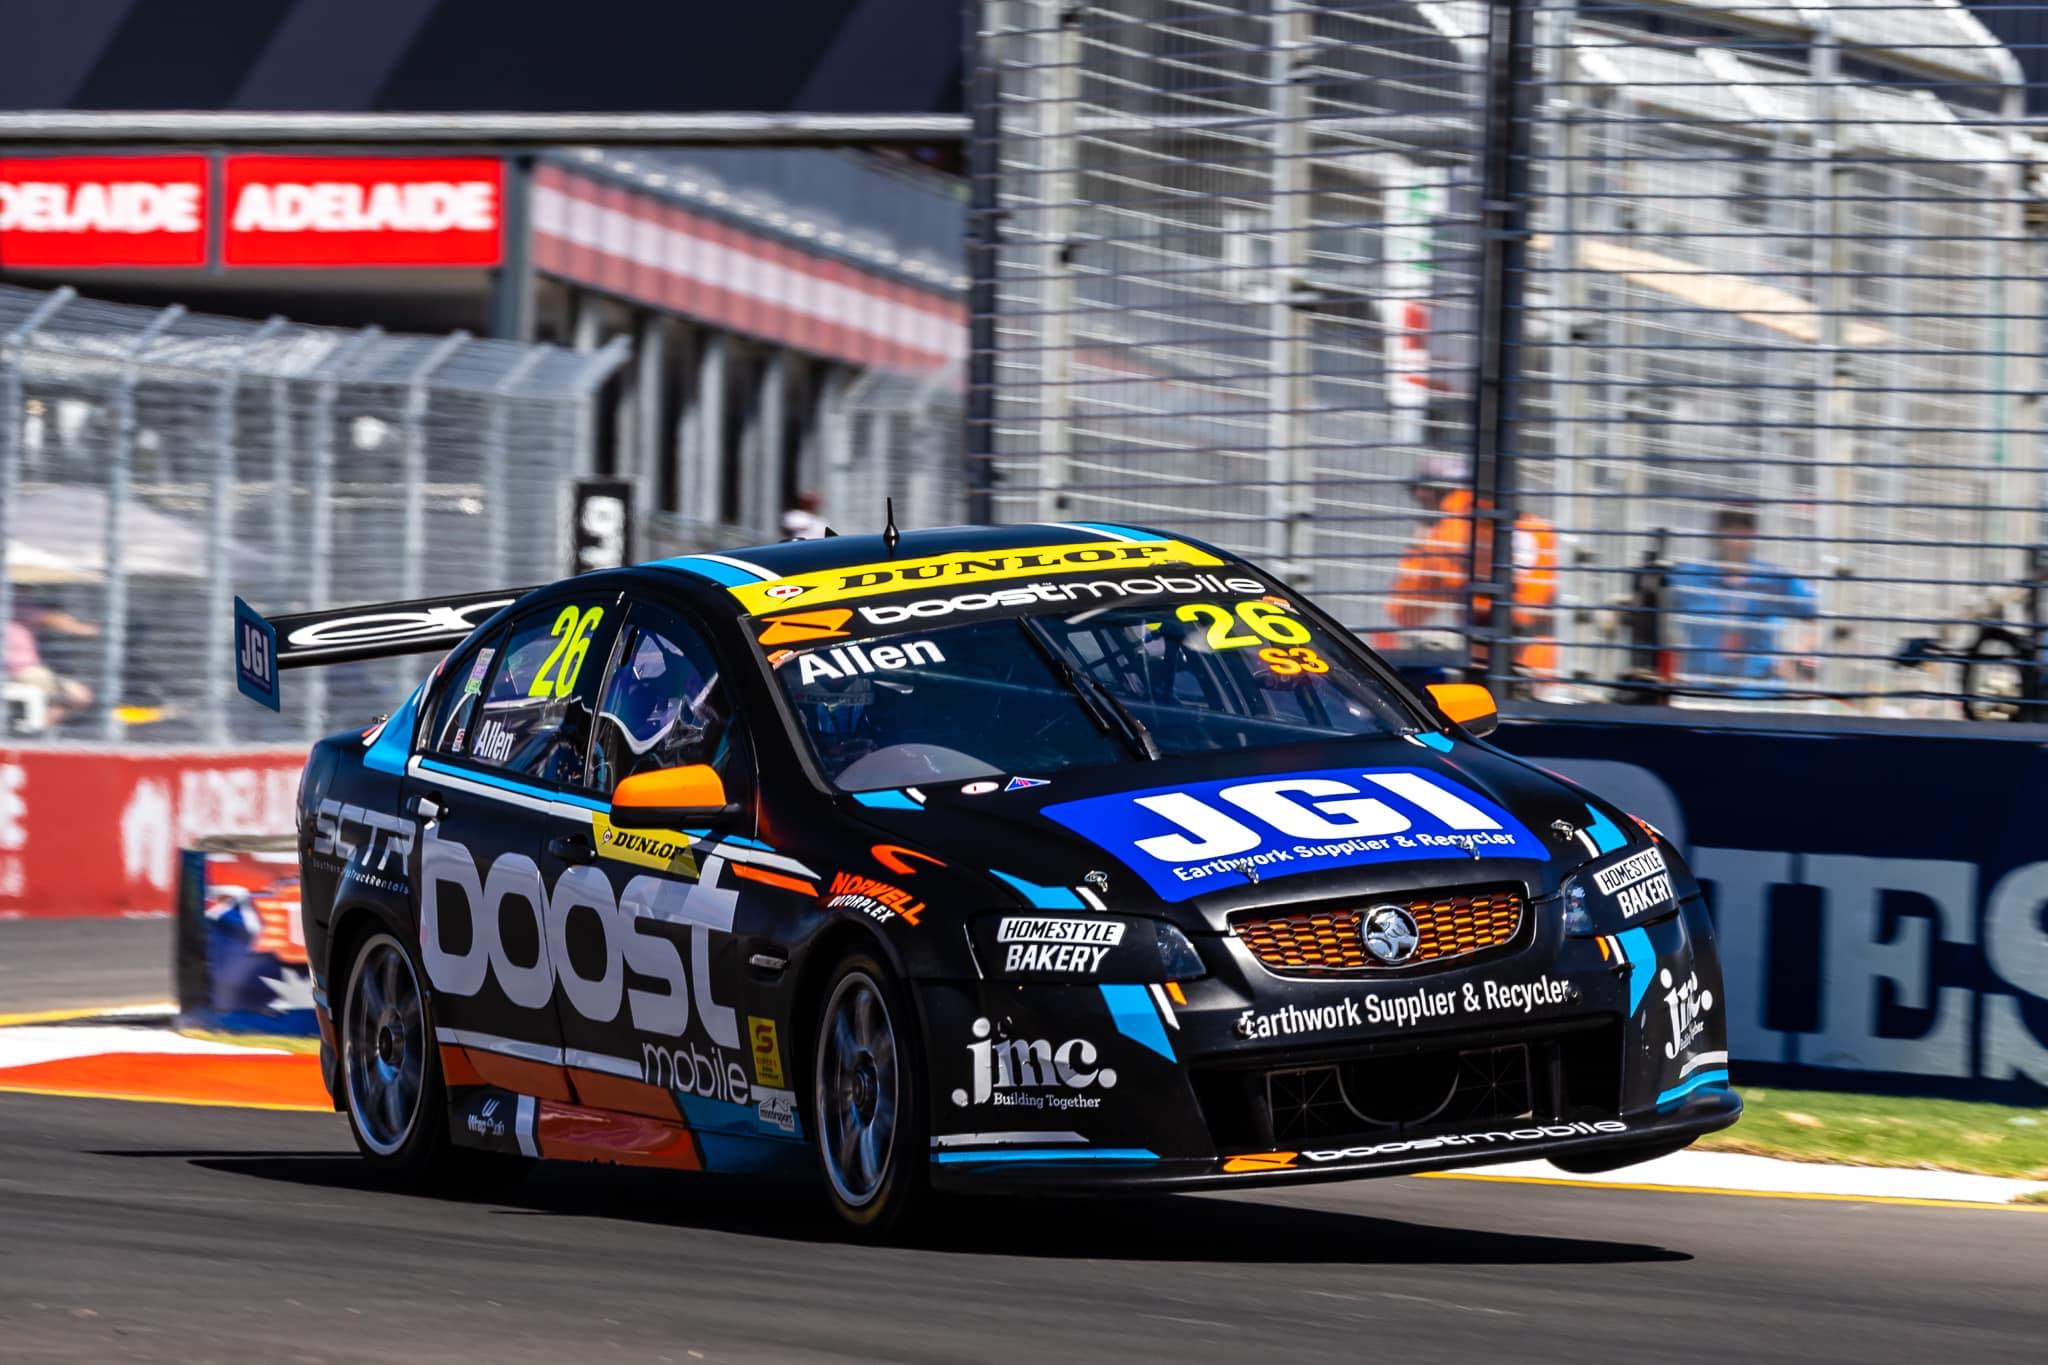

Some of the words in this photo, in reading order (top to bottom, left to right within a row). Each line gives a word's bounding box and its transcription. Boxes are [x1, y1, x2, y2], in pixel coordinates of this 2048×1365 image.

[232, 181, 496, 233] ADELAIDE
[838, 546, 1169, 591] DUNLOP
[1175, 600, 1311, 650] 26
[241, 623, 271, 682] JGI
[528, 605, 604, 699] 26
[799, 639, 946, 686] Allen
[1258, 647, 1330, 675] S3
[473, 719, 515, 762] Allen
[1133, 772, 1504, 863] JGI
[1173, 849, 1294, 882] Earthwork
[1293, 837, 1390, 859] Supplier
[1393, 834, 1418, 848] &
[1416, 831, 1516, 850] Recycler
[1600, 850, 1663, 892] HOMESTYLE
[829, 870, 926, 927] NORWELL
[1616, 872, 1674, 919] BAKERY
[420, 818, 740, 1050] boost
[1003, 919, 1118, 942] HOMESTYLE
[1004, 944, 1111, 973] BAKERY
[1240, 997, 1363, 1040] Earthwork
[1364, 987, 1457, 1028] Supplier
[1462, 982, 1482, 1013] &
[1483, 974, 1570, 1014] Recycler
[642, 1041, 749, 1105] mobile
[993, 1091, 1044, 1109] Building
[1045, 1092, 1102, 1111] Together
